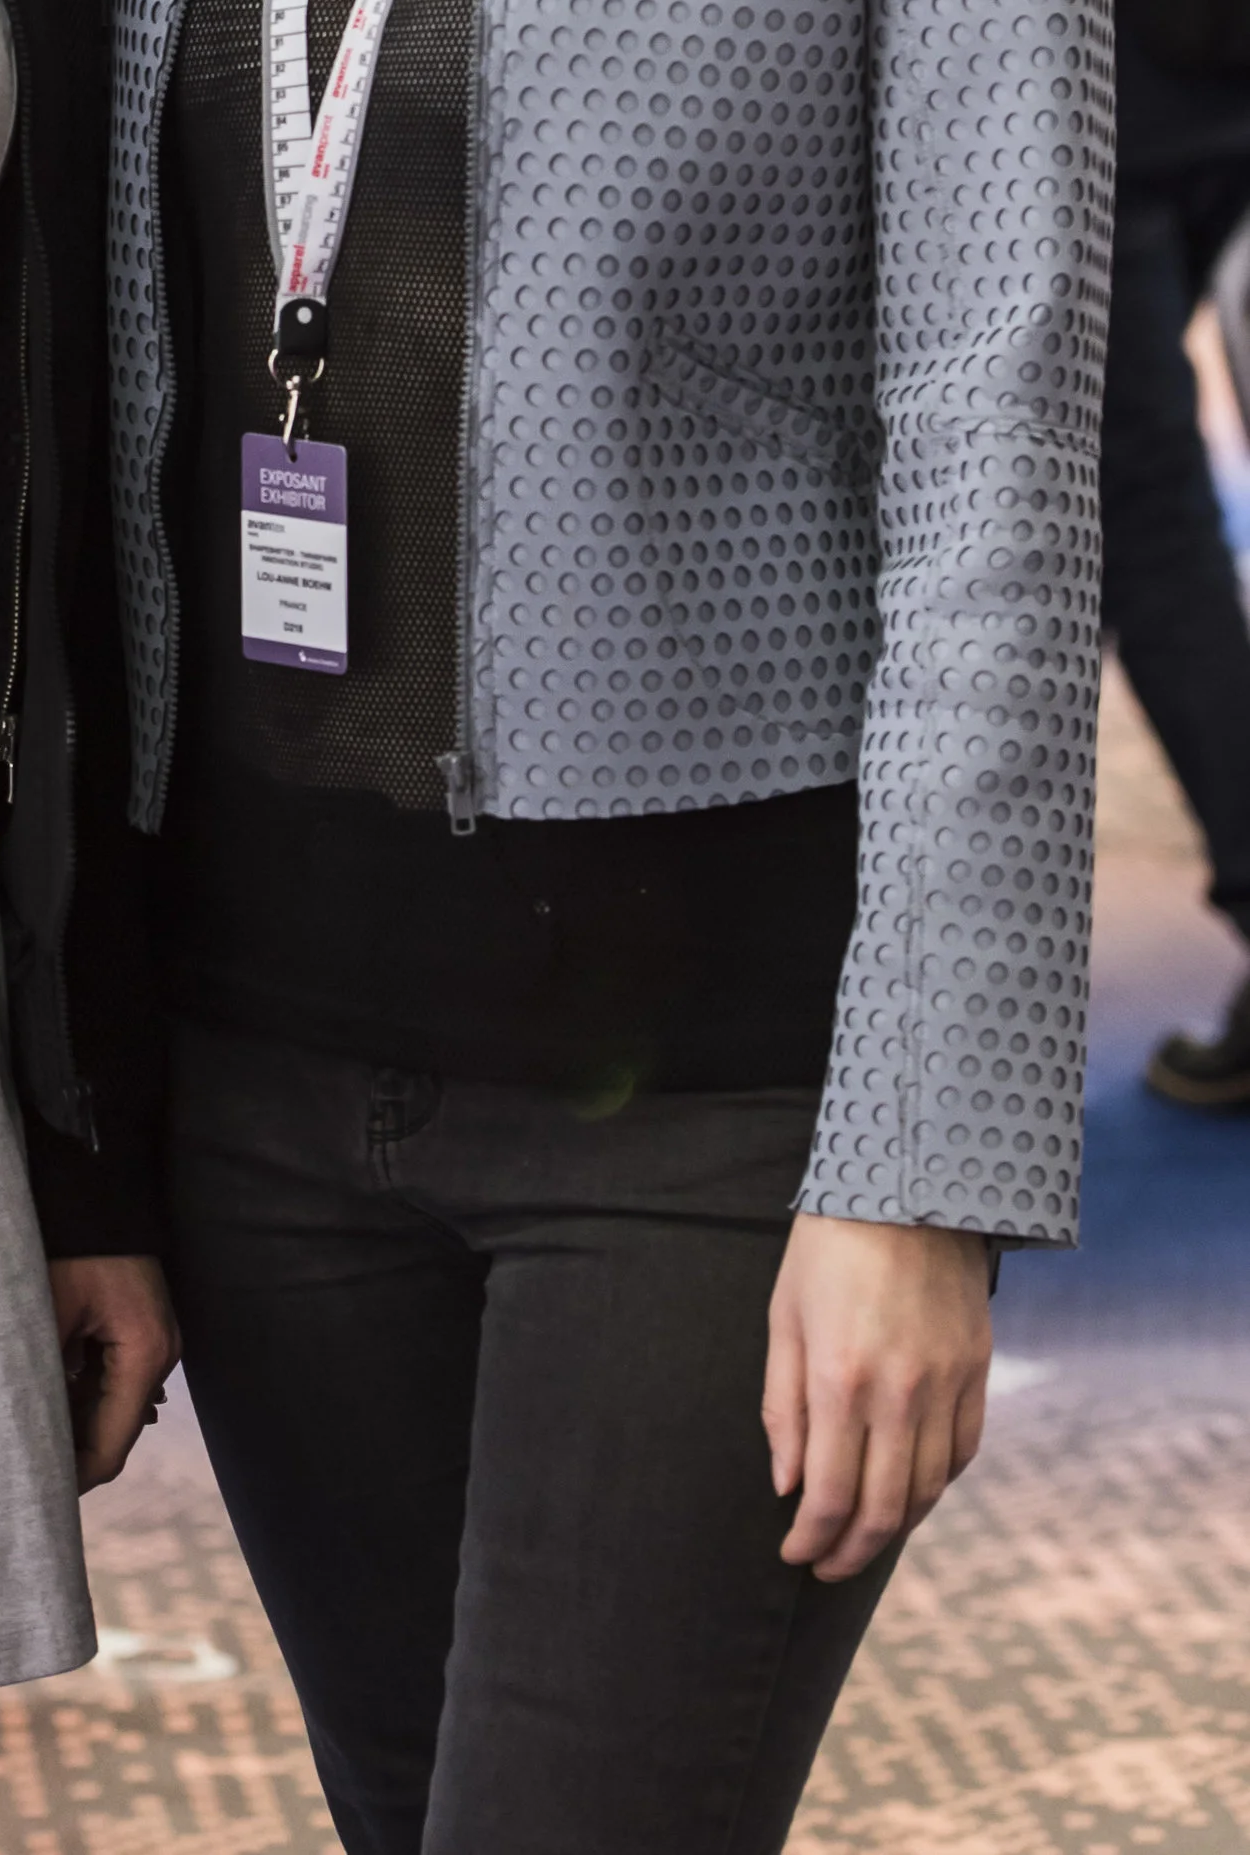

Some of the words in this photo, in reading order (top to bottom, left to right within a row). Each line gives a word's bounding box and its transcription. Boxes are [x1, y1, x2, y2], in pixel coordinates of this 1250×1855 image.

[312, 114, 334, 178] avanprint
[260, 467, 327, 492] EXPOSANT
[260, 486, 326, 511] EXHIBITOR
[257, 571, 299, 587] LOU-ANNE
